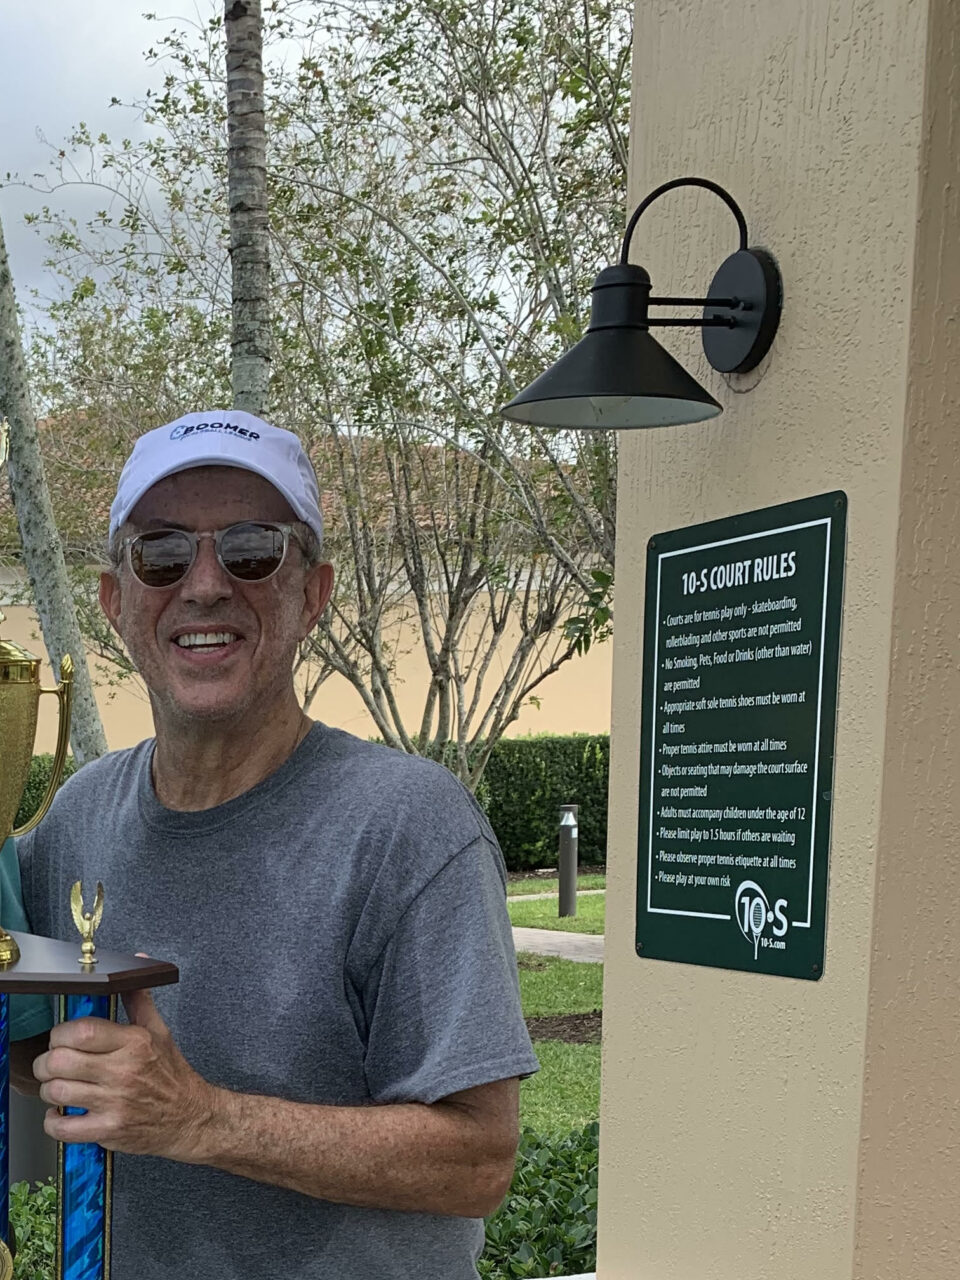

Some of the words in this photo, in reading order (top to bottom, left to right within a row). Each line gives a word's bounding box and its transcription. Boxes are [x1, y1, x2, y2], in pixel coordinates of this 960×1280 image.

[184, 422, 260, 440] BOOMER
[682, 568, 708, 595] 10-S
[710, 560, 752, 590] COURT
[754, 551, 796, 583] RULES
[667, 614, 683, 626] Courts
[684, 614, 693, 624] are
[694, 610, 702, 622] for
[703, 608, 720, 621] tennis
[720, 605, 733, 621] play
[734, 602, 747, 618] only
[666, 633, 700, 648] rollerblading
[701, 630, 712, 643] and
[712, 629, 728, 642] other
[728, 627, 746, 642] sports
[747, 627, 757, 637] are
[758, 624, 769, 636] not
[769, 617, 801, 638] permitted
[665, 658, 673, 670] No
[699, 654, 712, 667] Pets,
[713, 650, 727, 664] Food
[728, 653, 734, 662] or
[735, 648, 754, 662] Drinks
[755, 646, 774, 661] (other
[775, 644, 789, 657] than
[791, 640, 812, 655] water)
[664, 682, 672, 691] are
[673, 676, 700, 693] permitted
[664, 700, 695, 715] Appropriate
[696, 697, 706, 710] soft
[707, 697, 718, 709] sole
[720, 696, 737, 708] tennis
[738, 694, 754, 707] shoes
[756, 694, 771, 705] must
[772, 692, 780, 704] be
[781, 693, 797, 703] worn
[798, 691, 805, 702] at
[662, 722, 670, 734] all
[670, 722, 685, 733] times
[662, 743, 679, 757] Proper
[681, 742, 697, 754] tennis
[698, 741, 713, 754] attire
[714, 742, 728, 752] must
[729, 740, 736, 752] be
[737, 742, 752, 752] worn
[753, 740, 760, 751] at
[769, 738, 787, 751] times
[662, 764, 681, 778] Objects
[682, 766, 687, 775] or
[688, 764, 707, 778] seating
[708, 763, 719, 775] that
[720, 765, 732, 778] may
[733, 762, 756, 777] damage
[758, 761, 767, 774] the
[768, 763, 784, 774] court
[785, 760, 808, 773] surface
[661, 788, 670, 797] are
[671, 787, 679, 796] not
[680, 784, 707, 799] permitted
[660, 806, 677, 818] Adults
[678, 808, 691, 818] must
[692, 809, 723, 821] accompany
[723, 806, 746, 818] children
[748, 806, 765, 819] under
[766, 806, 776, 819] the
[777, 810, 789, 823] age
[790, 807, 797, 820] of
[798, 807, 805, 820] 12
[660, 827, 676, 838] Please
[677, 827, 690, 839] limit
[690, 828, 702, 842] play
[703, 829, 709, 840] to
[710, 829, 719, 840] 1.5
[720, 828, 735, 840] hours
[736, 829, 742, 841] if
[742, 829, 760, 842] others
[761, 832, 771, 842] are
[772, 830, 795, 846] waiting
[659, 850, 676, 862] Please
[677, 851, 697, 864] observe
[698, 855, 716, 866] proper
[717, 854, 734, 865] tennis
[735, 854, 762, 869] etiquette
[763, 857, 769, 867] at
[770, 855, 778, 868] all
[779, 856, 796, 869] times
[659, 871, 675, 883] Please
[676, 872, 687, 887] play
[688, 875, 694, 884] at
[694, 876, 707, 887] your
[707, 877, 719, 886] own
[720, 875, 731, 887] risk
[761, 937, 786, 949] 10-S.com
